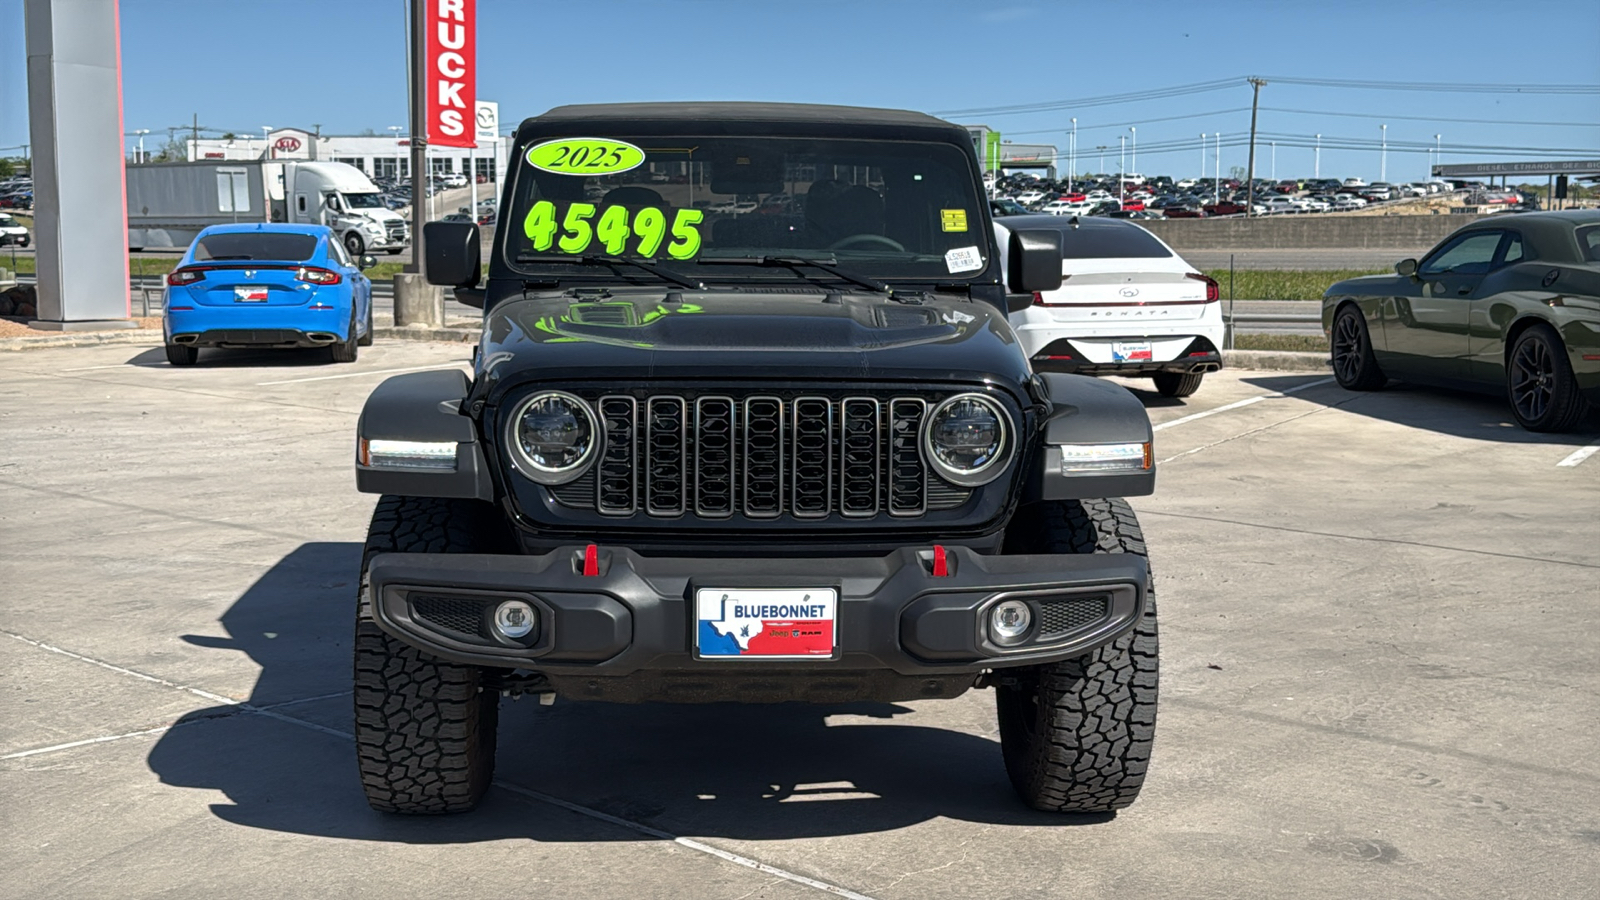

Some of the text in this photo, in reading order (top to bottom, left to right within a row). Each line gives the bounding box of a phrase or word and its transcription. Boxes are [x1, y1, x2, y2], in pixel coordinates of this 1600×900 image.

[279, 140, 299, 150] KIA
[547, 146, 628, 168] 2025
[1477, 164, 1507, 172] DIESEL
[1514, 162, 1554, 171] ETHANOL
[523, 200, 704, 260] 45495
[734, 604, 826, 619] BLUEBONNET
[769, 629, 789, 638] Jeep
